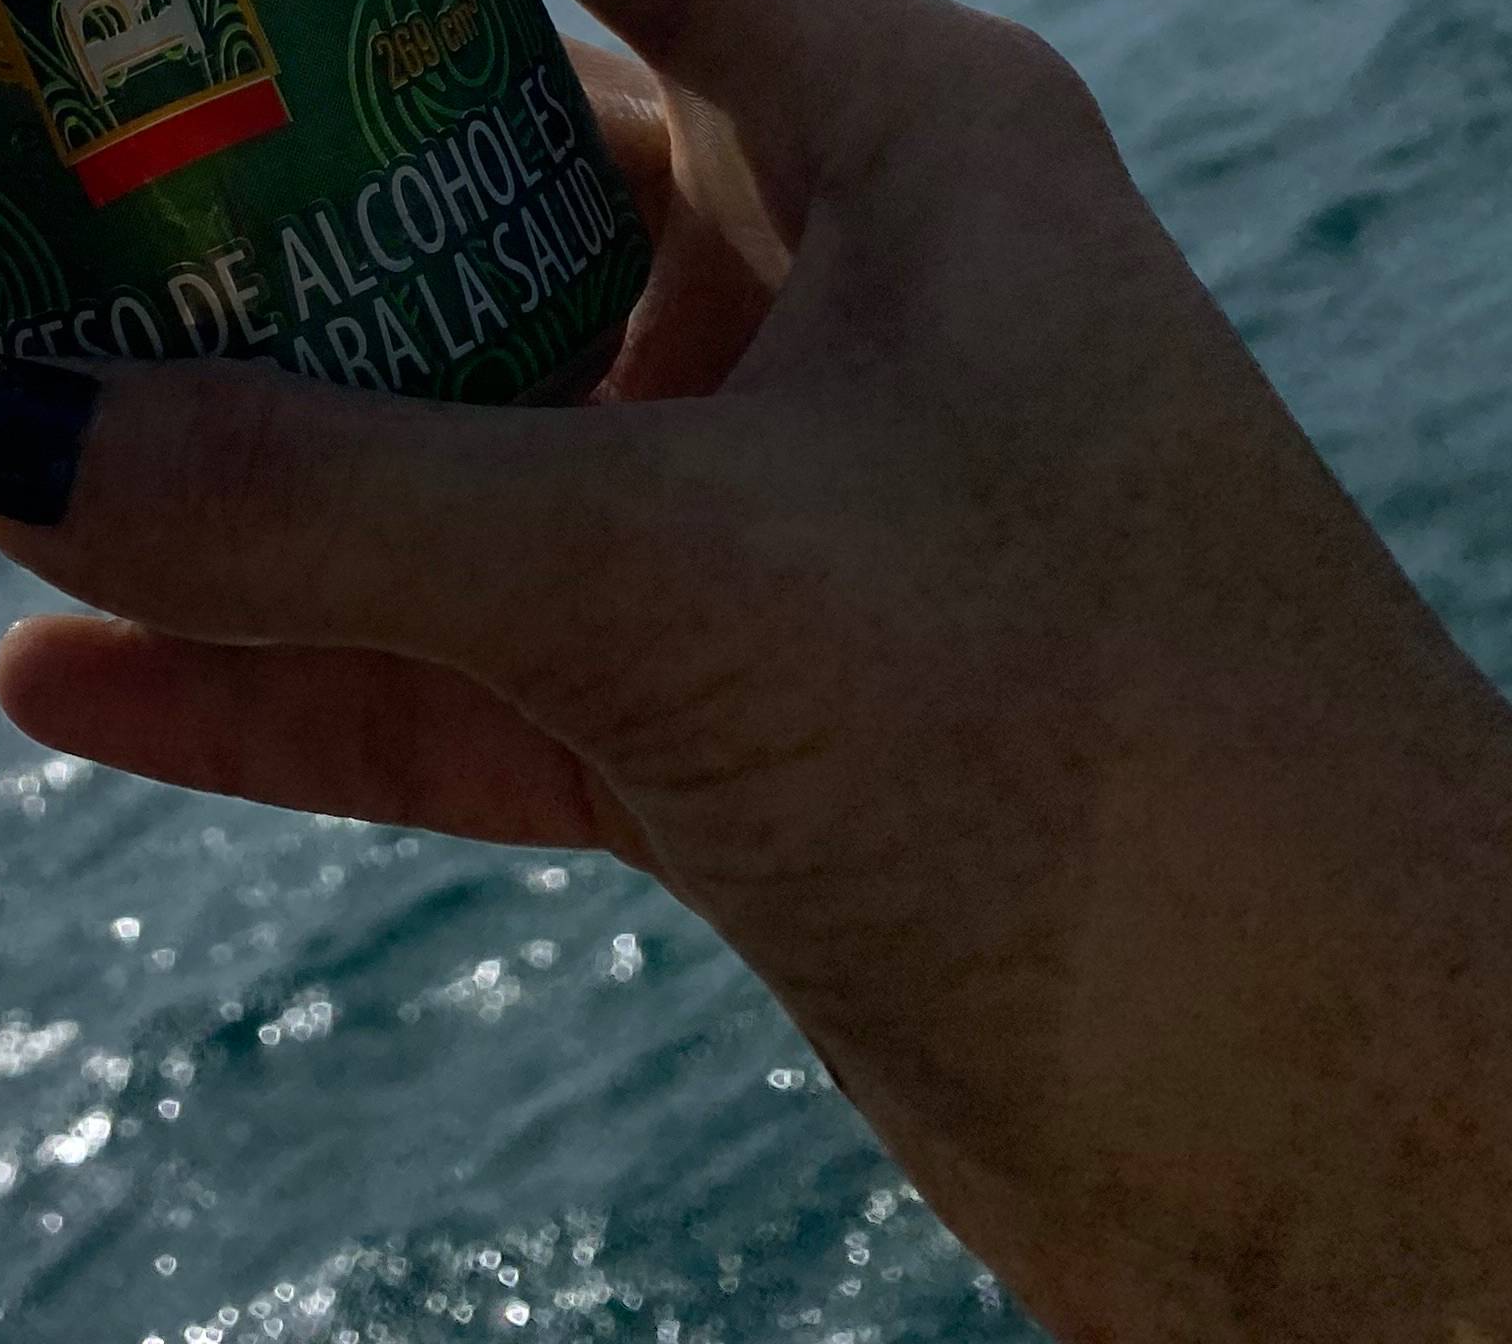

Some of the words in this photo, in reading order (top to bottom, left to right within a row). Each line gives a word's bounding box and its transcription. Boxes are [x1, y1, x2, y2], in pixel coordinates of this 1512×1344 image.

[371, 12, 440, 91] 269
[167, 249, 279, 358] DE
[280, 106, 542, 322] ALCOHOL
[520, 64, 575, 163] ES
[415, 250, 509, 360] LA
[492, 156, 616, 313] SALUD
